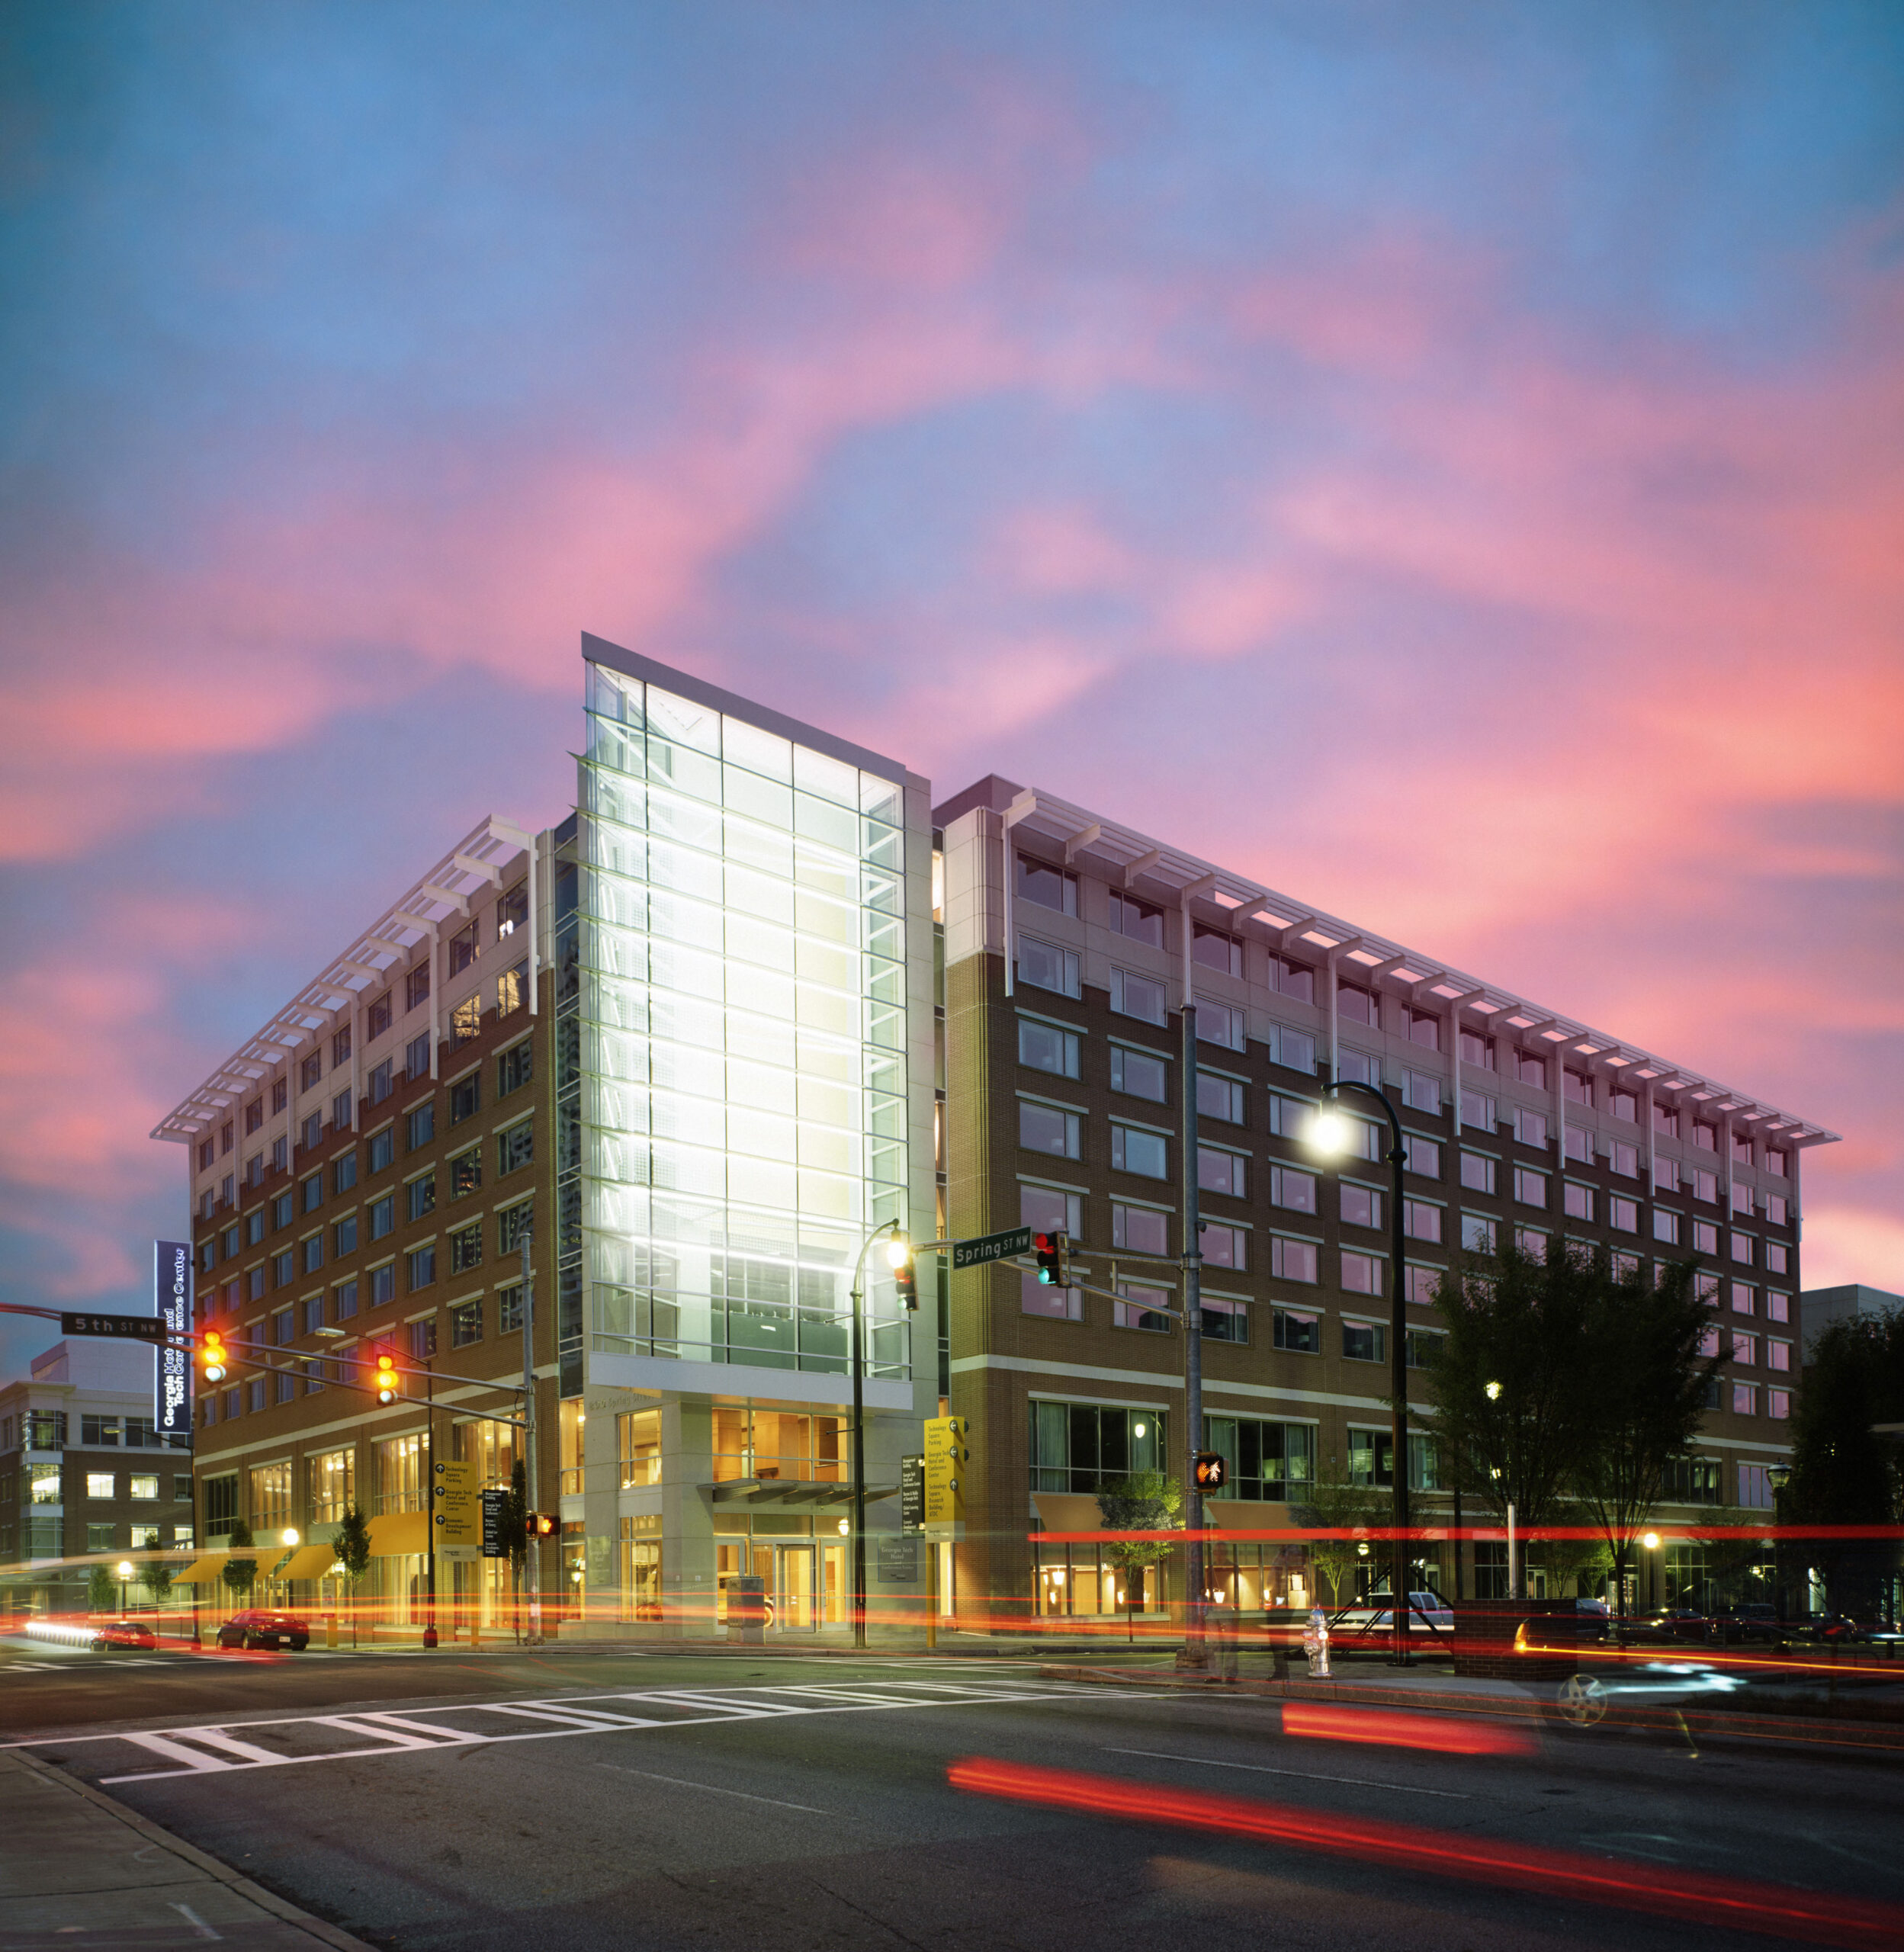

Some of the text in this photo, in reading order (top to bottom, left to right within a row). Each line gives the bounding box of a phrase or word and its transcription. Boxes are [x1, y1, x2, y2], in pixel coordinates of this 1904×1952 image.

[956, 1234, 1029, 1263] Spring ST NW
[173, 1247, 185, 1295] Center
[75, 1318, 156, 1334] 5th ST NW
[164, 1375, 176, 1427] Georgia
[174, 1376, 185, 1407] Tech
